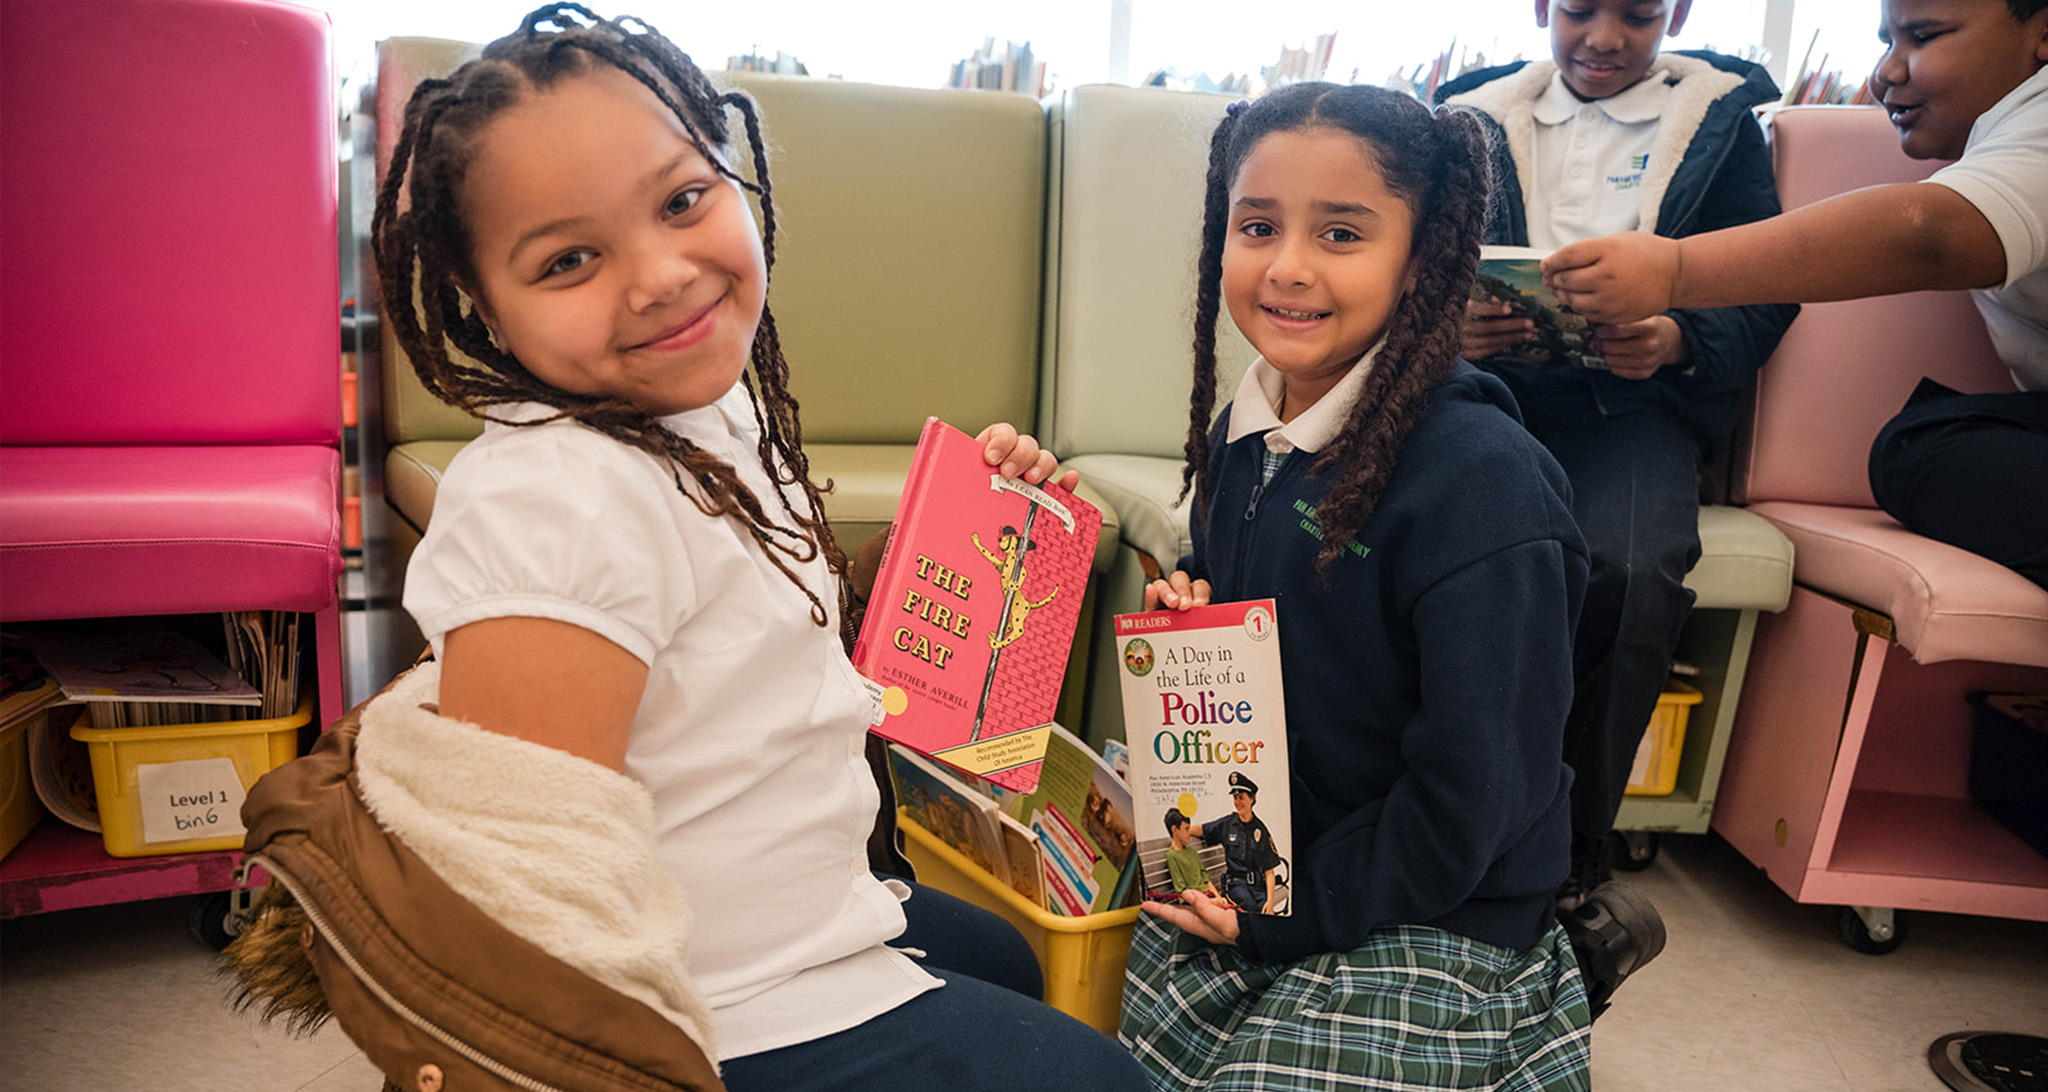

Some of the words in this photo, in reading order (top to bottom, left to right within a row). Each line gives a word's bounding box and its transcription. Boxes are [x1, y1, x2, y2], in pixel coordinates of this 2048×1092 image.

[1292, 499, 1309, 514] PAN
[916, 553, 972, 601] THE
[902, 588, 972, 640] FIRE
[1134, 616, 1171, 629] READERS
[1253, 616, 1261, 632] 1
[893, 626, 953, 673] CAT
[1165, 648, 1178, 665] A
[1182, 646, 1213, 666] Day
[1218, 645, 1233, 661] in
[1156, 670, 1180, 688] the
[1184, 667, 1212, 686] Life
[1216, 665, 1232, 684] of
[1235, 671, 1246, 684] a
[891, 667, 928, 691] ESTHER
[931, 686, 969, 710] AVERILL
[1159, 690, 1252, 726] Police
[976, 738, 1015, 754] Recommended
[976, 753, 991, 764] Child
[991, 750, 1006, 760] Study
[1007, 742, 1036, 754] Association
[1153, 730, 1264, 765] Officer
[170, 791, 213, 807] Level
[219, 790, 228, 803] 1
[175, 814, 205, 831] bin
[206, 807, 218, 825] 6
